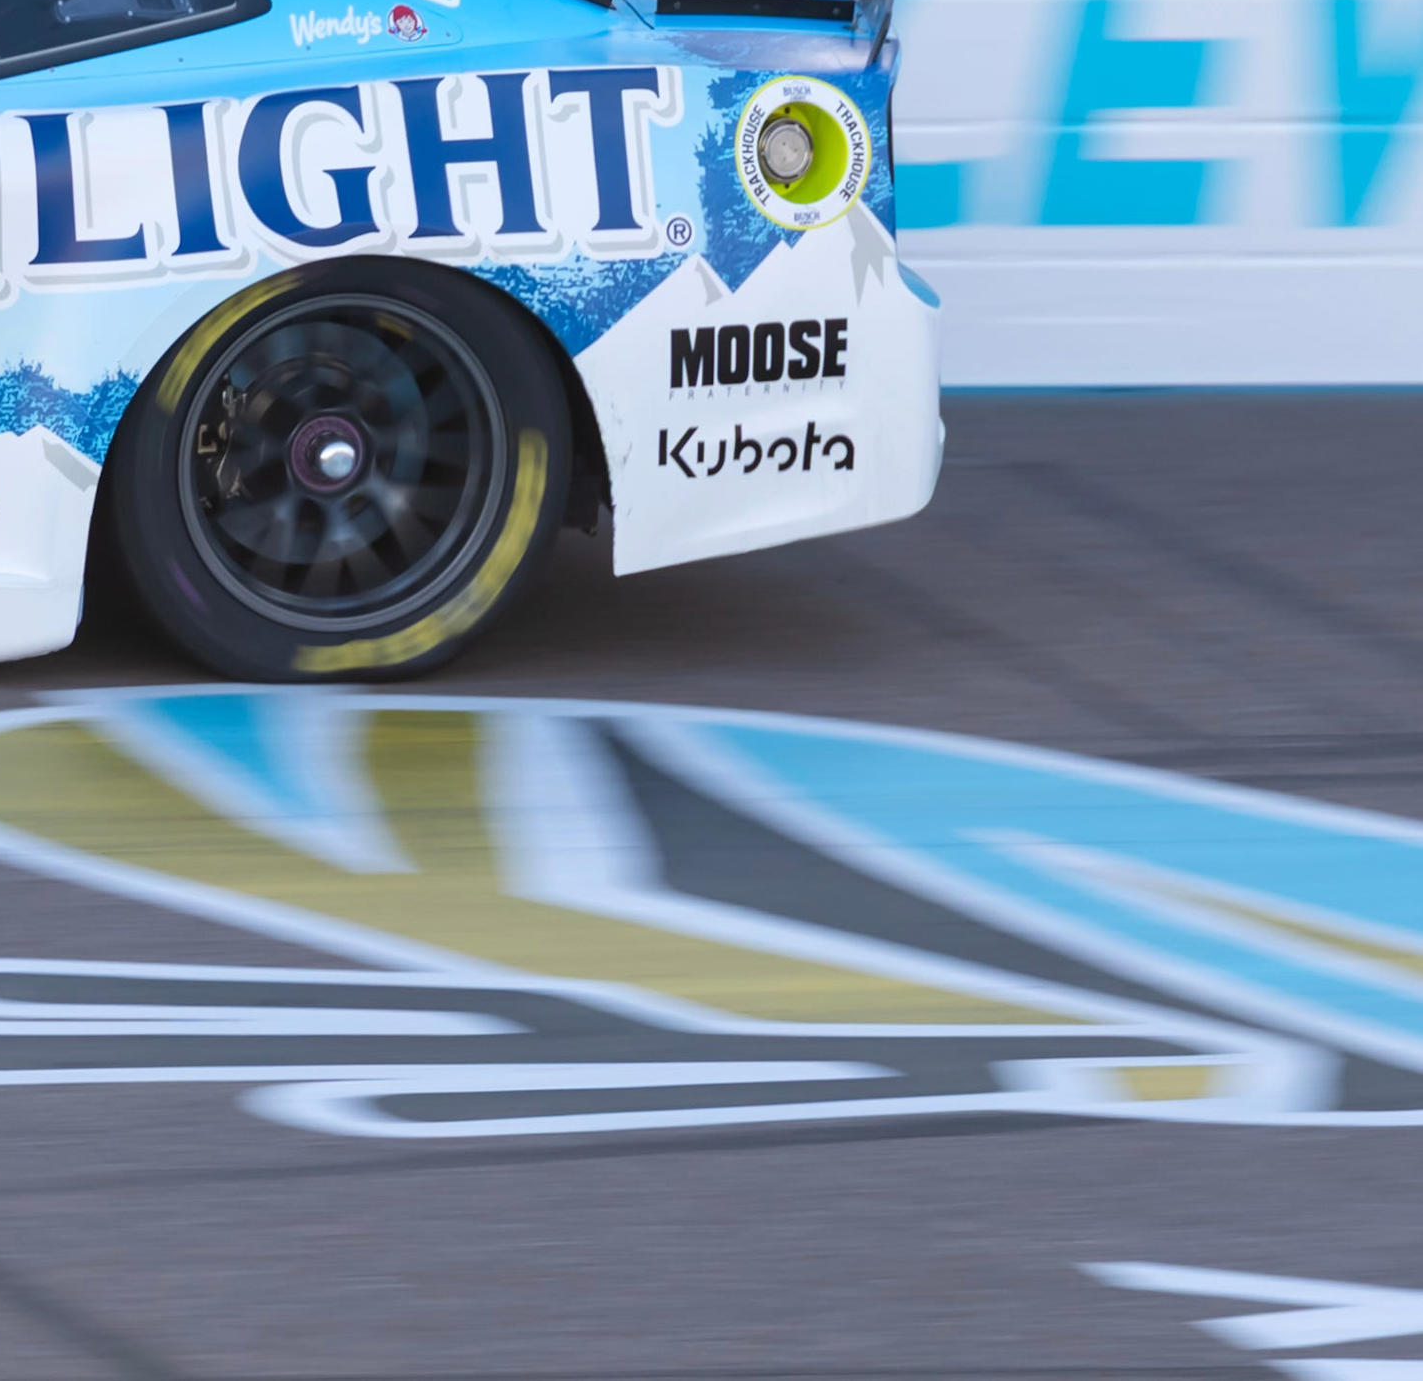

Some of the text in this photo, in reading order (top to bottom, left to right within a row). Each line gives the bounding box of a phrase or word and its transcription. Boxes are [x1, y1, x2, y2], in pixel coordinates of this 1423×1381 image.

[289, 5, 382, 47] Wendy's
[741, 104, 772, 207] TRACKHOUSE
[833, 100, 865, 204] TRACKHOUSE
[670, 317, 848, 388] MOOSE
[668, 378, 846, 401] FRATERNITY
[658, 421, 855, 478] Kubota
